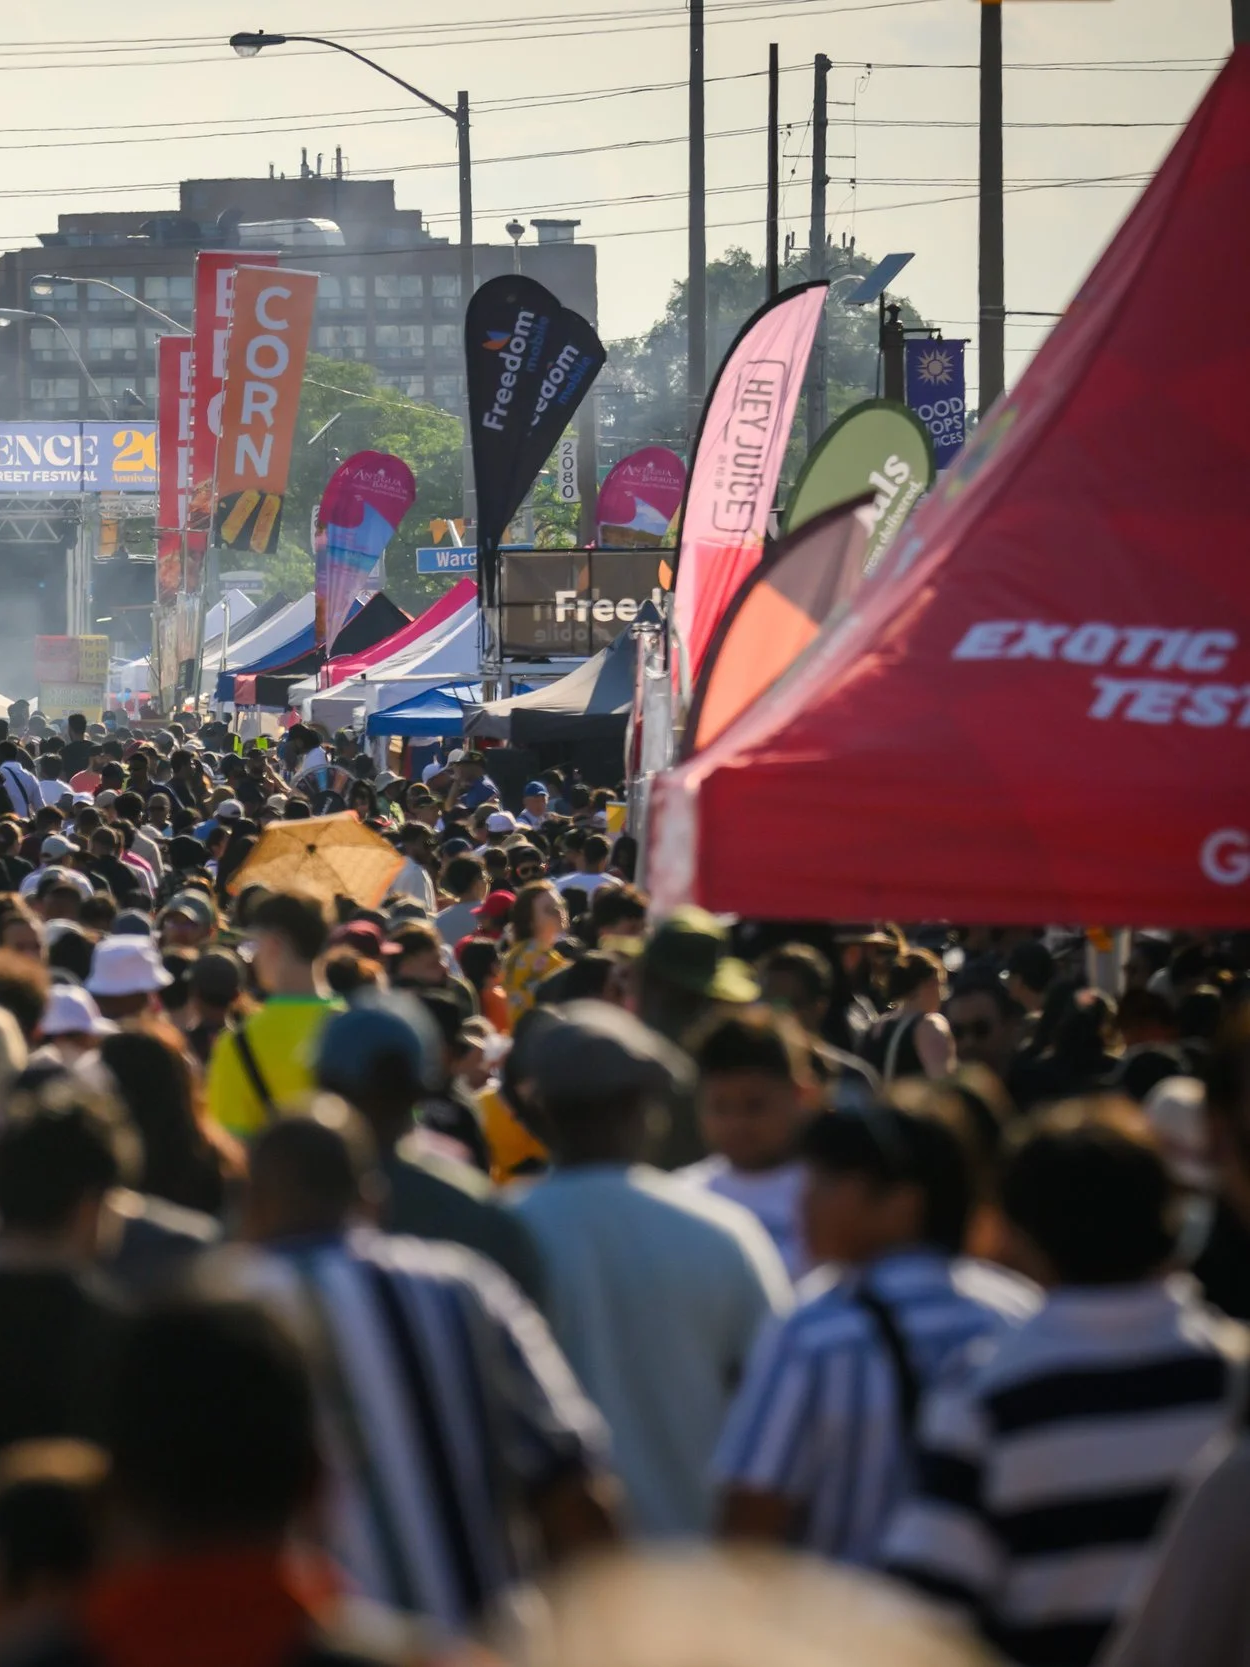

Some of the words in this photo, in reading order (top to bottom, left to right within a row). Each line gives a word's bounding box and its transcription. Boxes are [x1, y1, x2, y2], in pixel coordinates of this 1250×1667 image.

[482, 311, 534, 431] Freedom
[526, 316, 549, 372] mobile
[234, 286, 292, 478] CORN
[531, 345, 579, 426] edom
[739, 379, 775, 431] HEY
[913, 397, 963, 421] OOD
[926, 415, 963, 434] OPS
[33, 470, 98, 482] FESTIVAL
[111, 472, 157, 484] Anniver
[561, 441, 575, 499] 2080
[726, 436, 764, 514] JUICE
[951, 619, 1238, 673] EXOTIC
